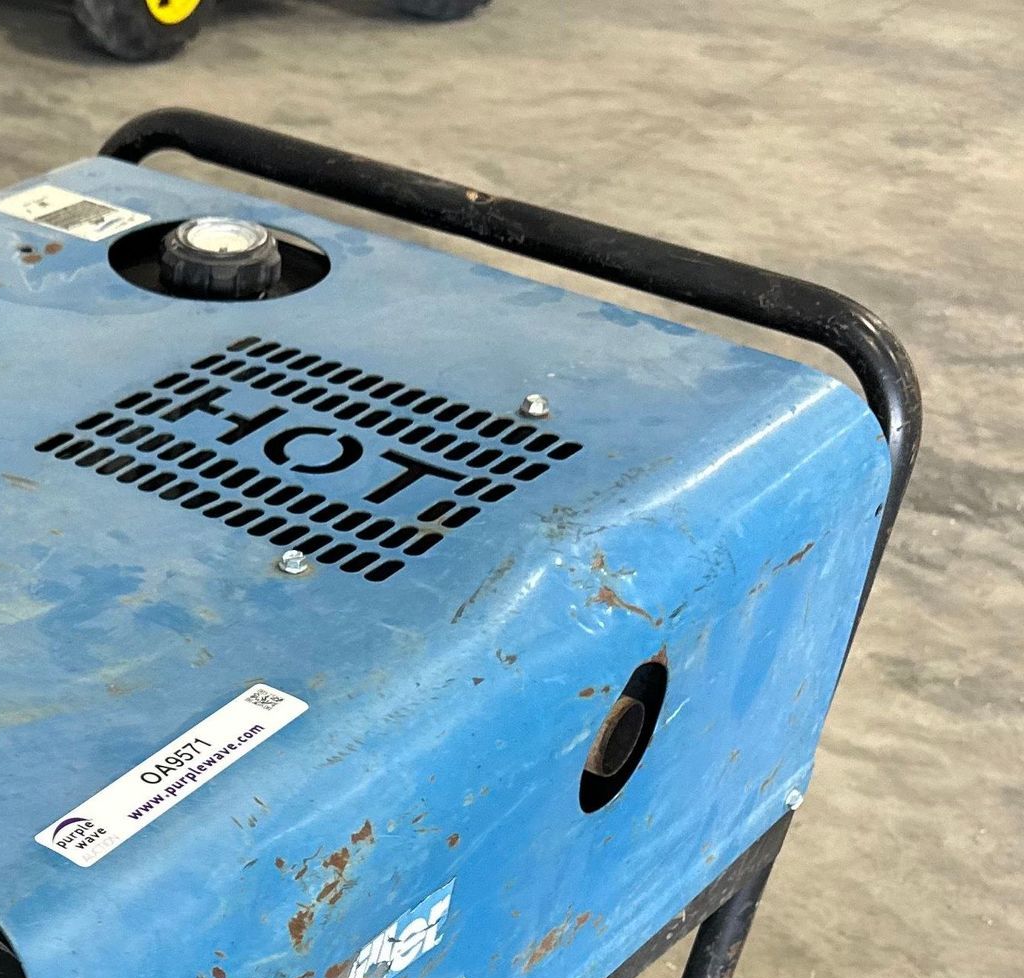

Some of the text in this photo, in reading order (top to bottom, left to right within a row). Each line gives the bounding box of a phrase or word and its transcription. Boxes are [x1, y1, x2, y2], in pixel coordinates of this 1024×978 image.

[157, 387, 467, 504] HOT
[128, 723, 265, 821] www.purplewave.com
[140, 738, 212, 785] OA9571
[56, 819, 94, 849] purple
[75, 826, 107, 850] wave
